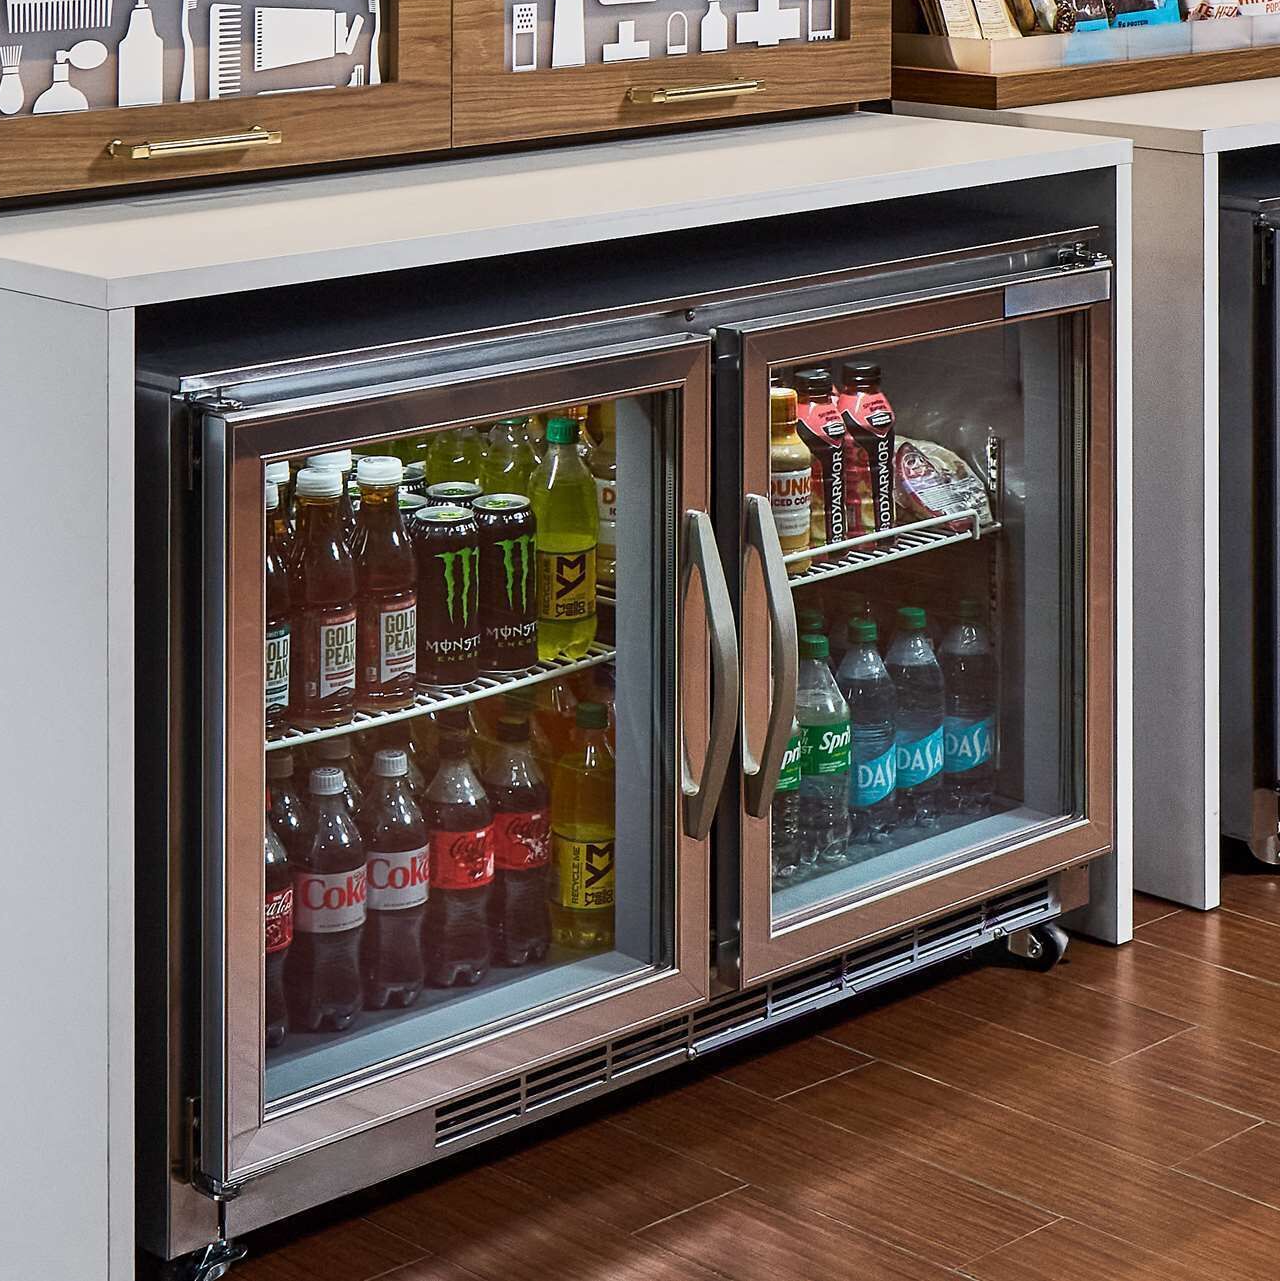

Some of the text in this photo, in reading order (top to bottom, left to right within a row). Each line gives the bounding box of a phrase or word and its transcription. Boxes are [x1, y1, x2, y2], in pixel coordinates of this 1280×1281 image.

[770, 477, 811, 499] DUNK
[831, 447, 843, 545] BODYARMOR
[878, 440, 889, 532] BODYARMOR
[773, 497, 792, 508] CED
[385, 609, 415, 634] GOLD
[486, 620, 537, 639] MONST
[325, 623, 354, 648] GOLD
[384, 629, 416, 653] PEAK
[426, 634, 481, 655] MONST
[267, 638, 289, 662] OLD
[325, 643, 355, 667] PEAK
[266, 659, 289, 682] EAK
[897, 735, 944, 778] DASA
[945, 727, 992, 765] DASA
[858, 754, 896, 792] DAS
[368, 855, 430, 890] Coke
[301, 875, 367, 911] Coke
